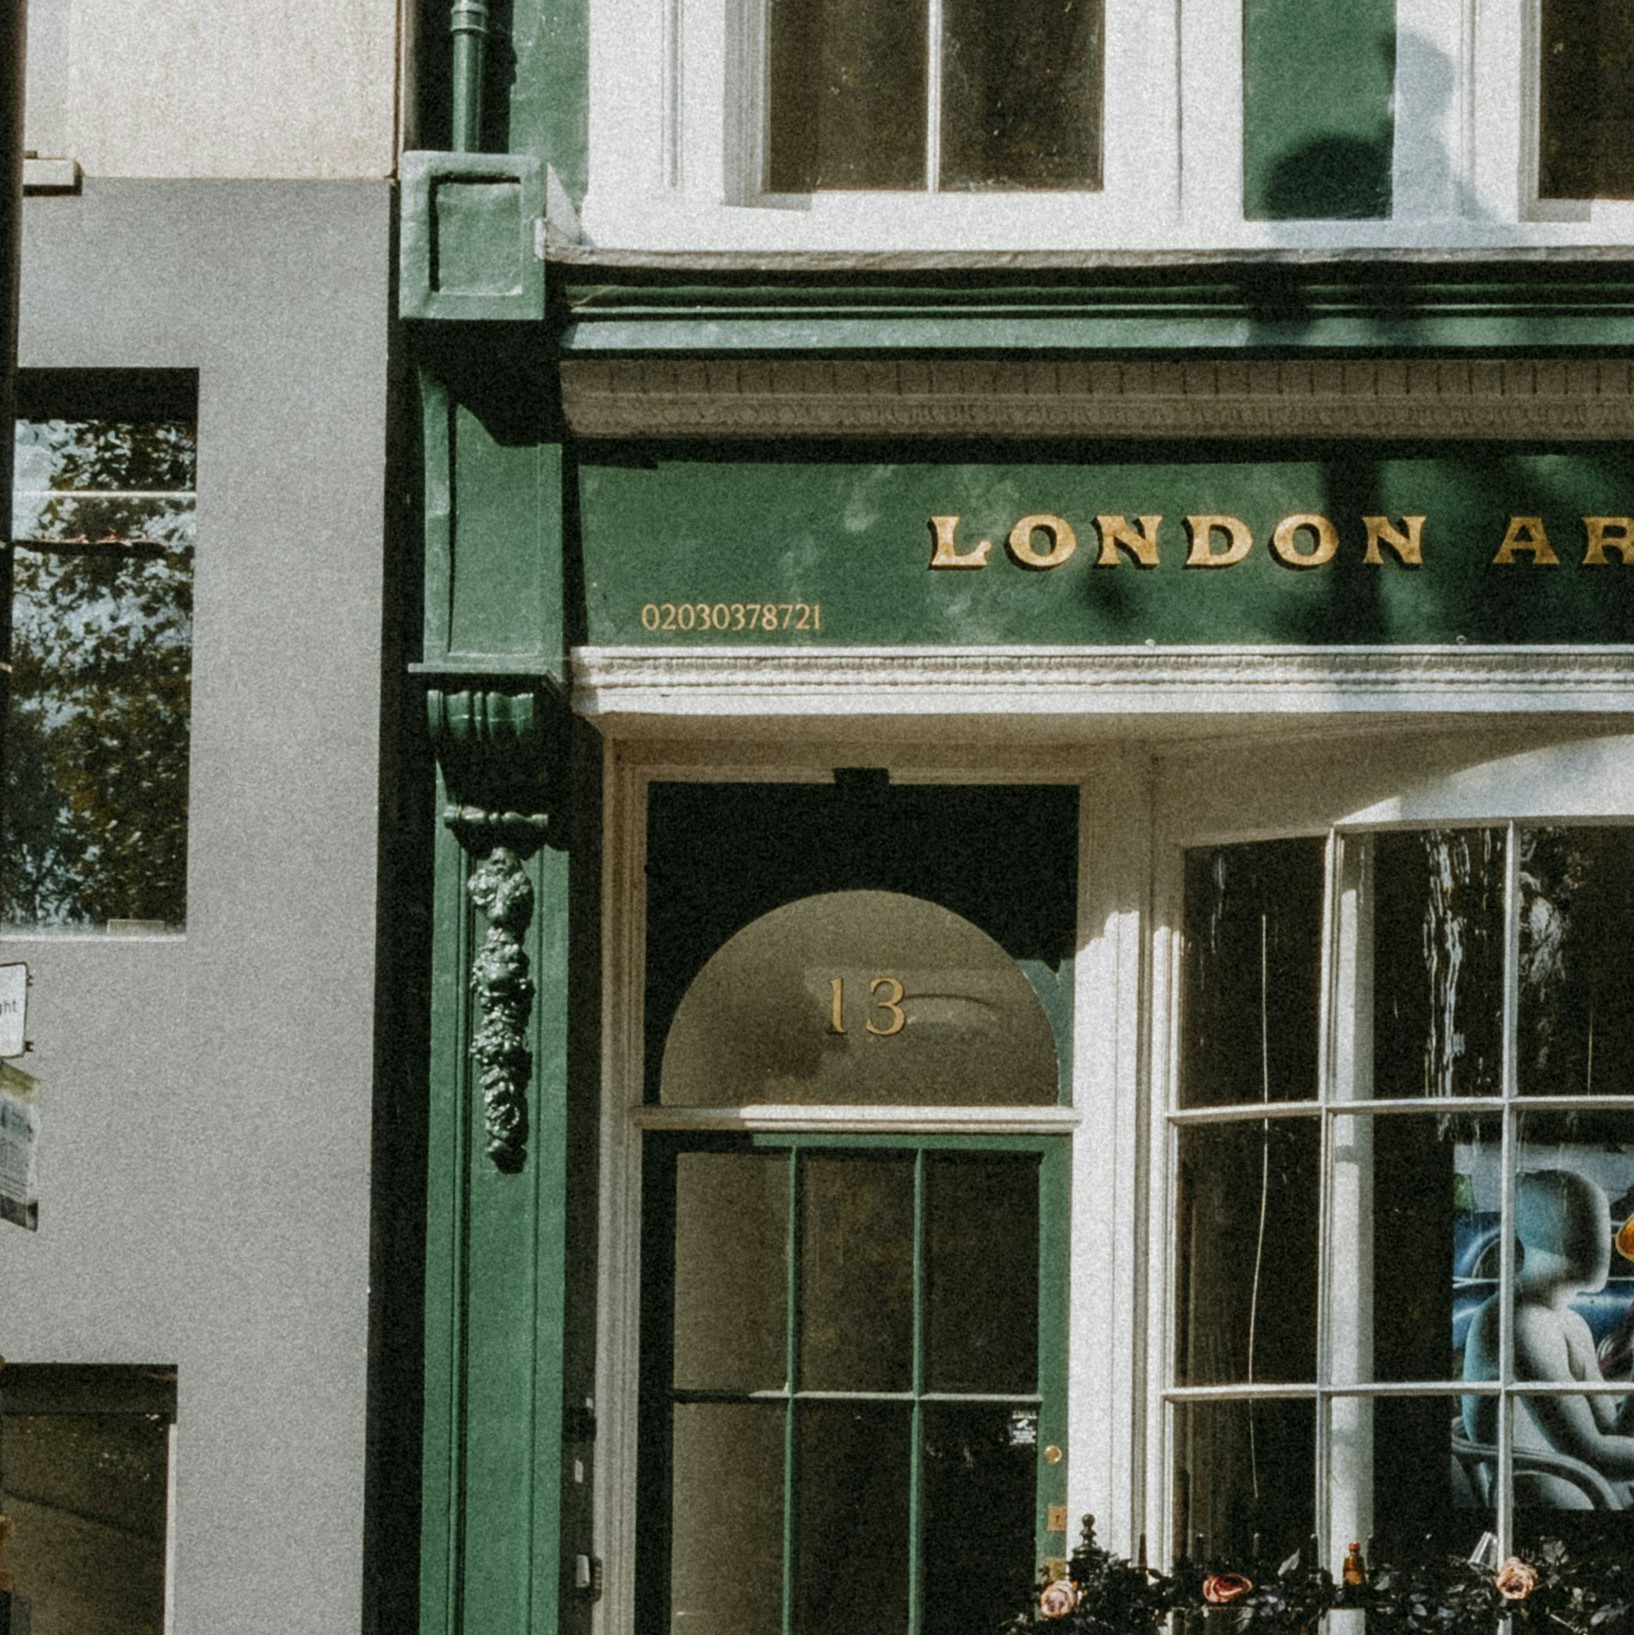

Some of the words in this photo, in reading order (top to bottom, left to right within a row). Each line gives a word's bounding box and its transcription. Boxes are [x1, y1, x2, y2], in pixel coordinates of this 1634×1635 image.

[928, 513, 1426, 568] LONDON
[641, 602, 822, 631] 02030378721
[829, 977, 907, 1036] 13
